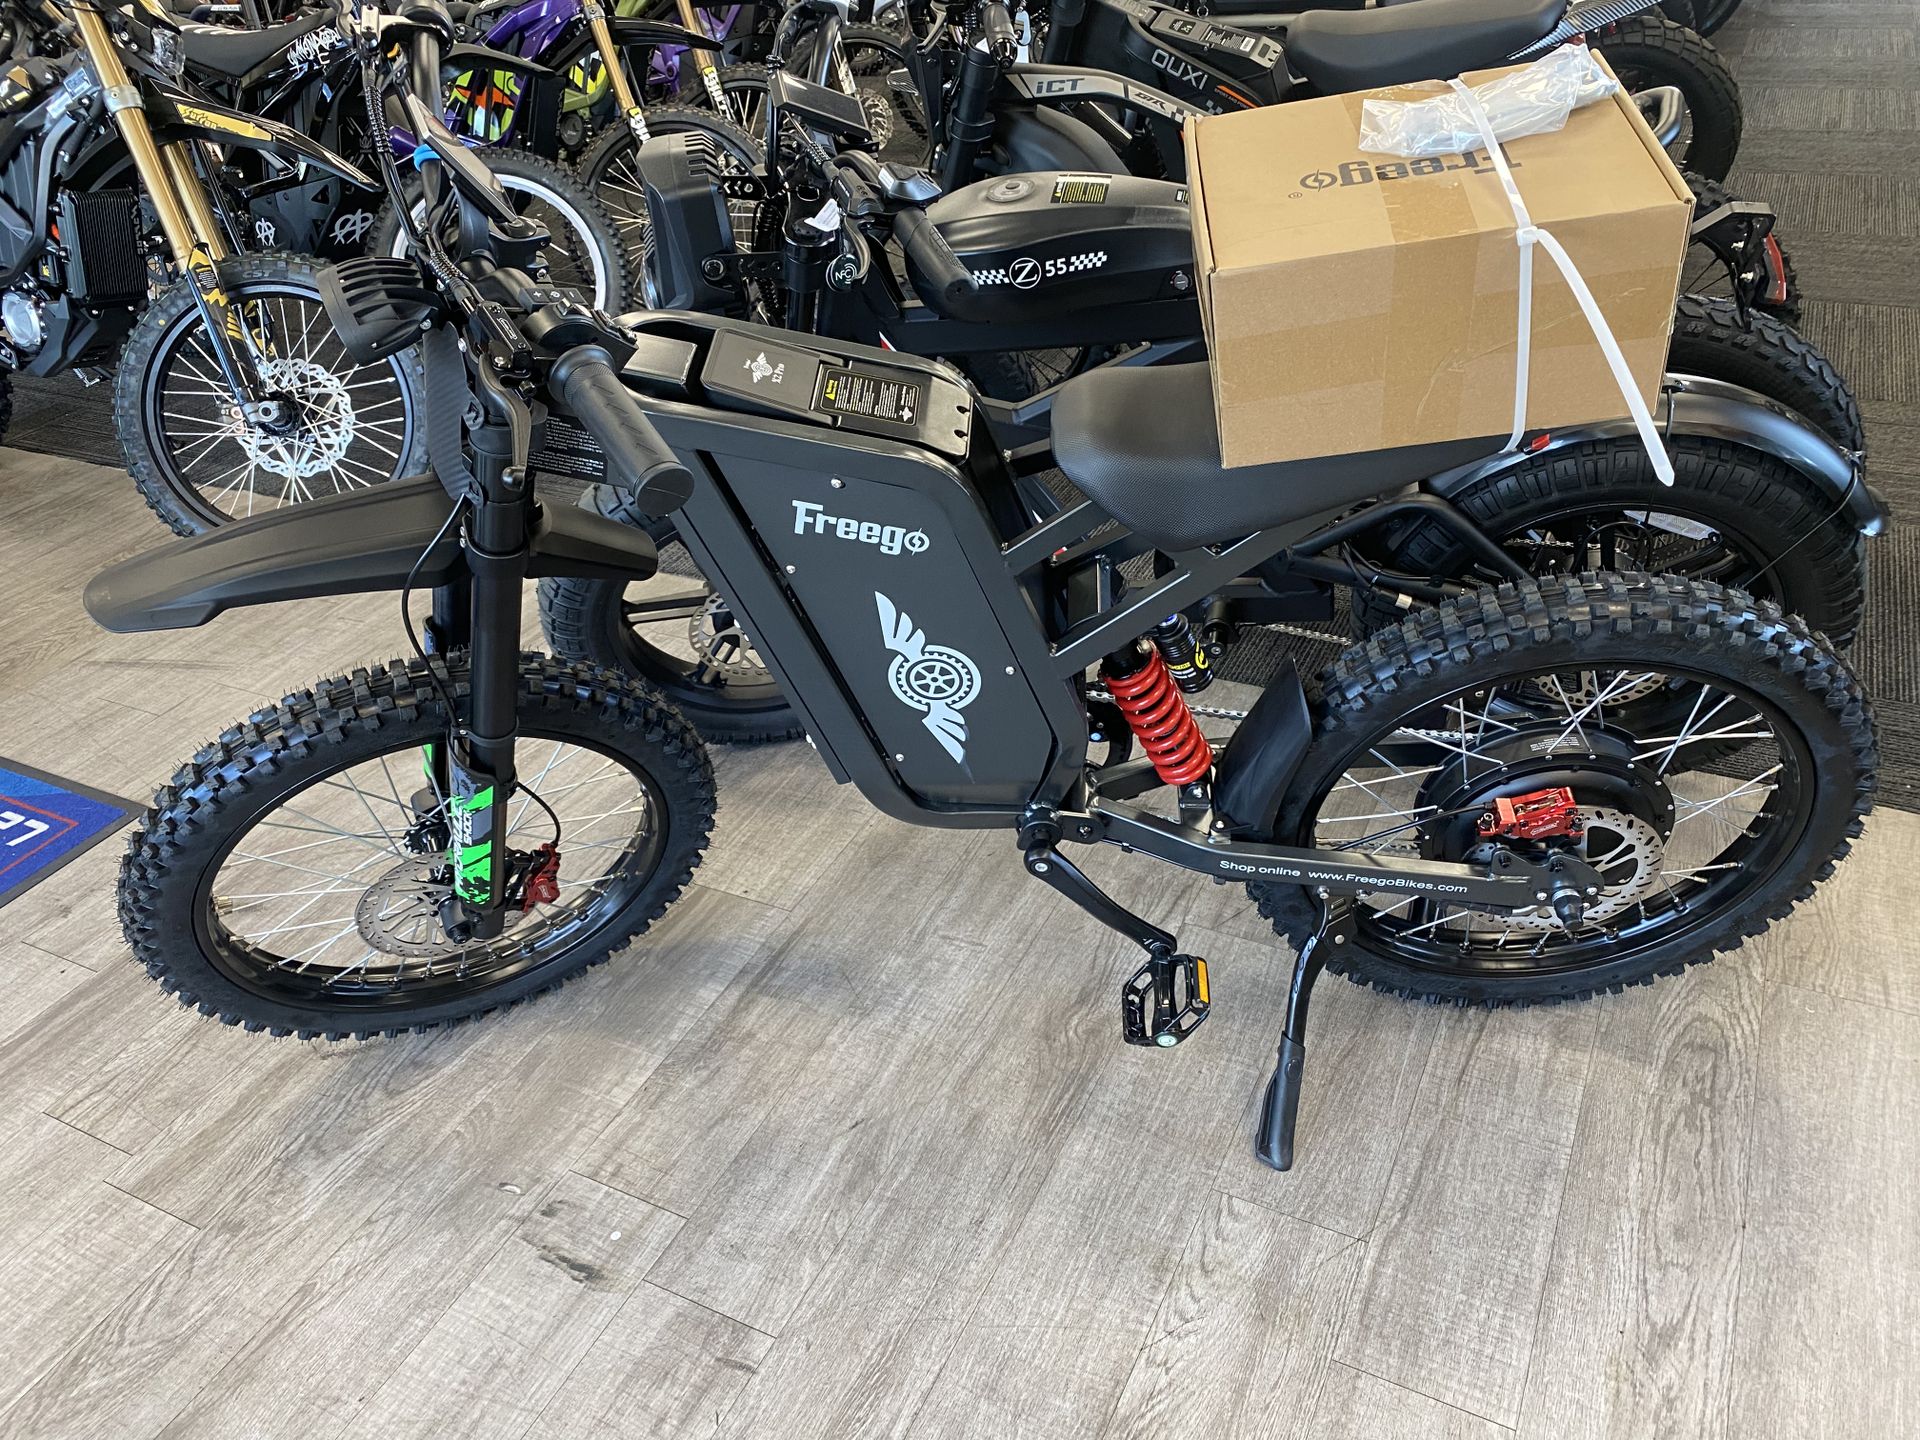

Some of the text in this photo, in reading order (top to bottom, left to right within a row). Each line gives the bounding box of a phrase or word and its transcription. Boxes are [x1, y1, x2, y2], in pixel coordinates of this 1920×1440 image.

[1035, 78, 1085, 95] iCT
[834, 268, 854, 281] NFC
[1045, 257, 1068, 278] 55
[791, 499, 931, 556] Freego
[462, 810, 473, 846] SHOCK
[1218, 860, 1468, 894] Shop online www.FreegoBikes.com
